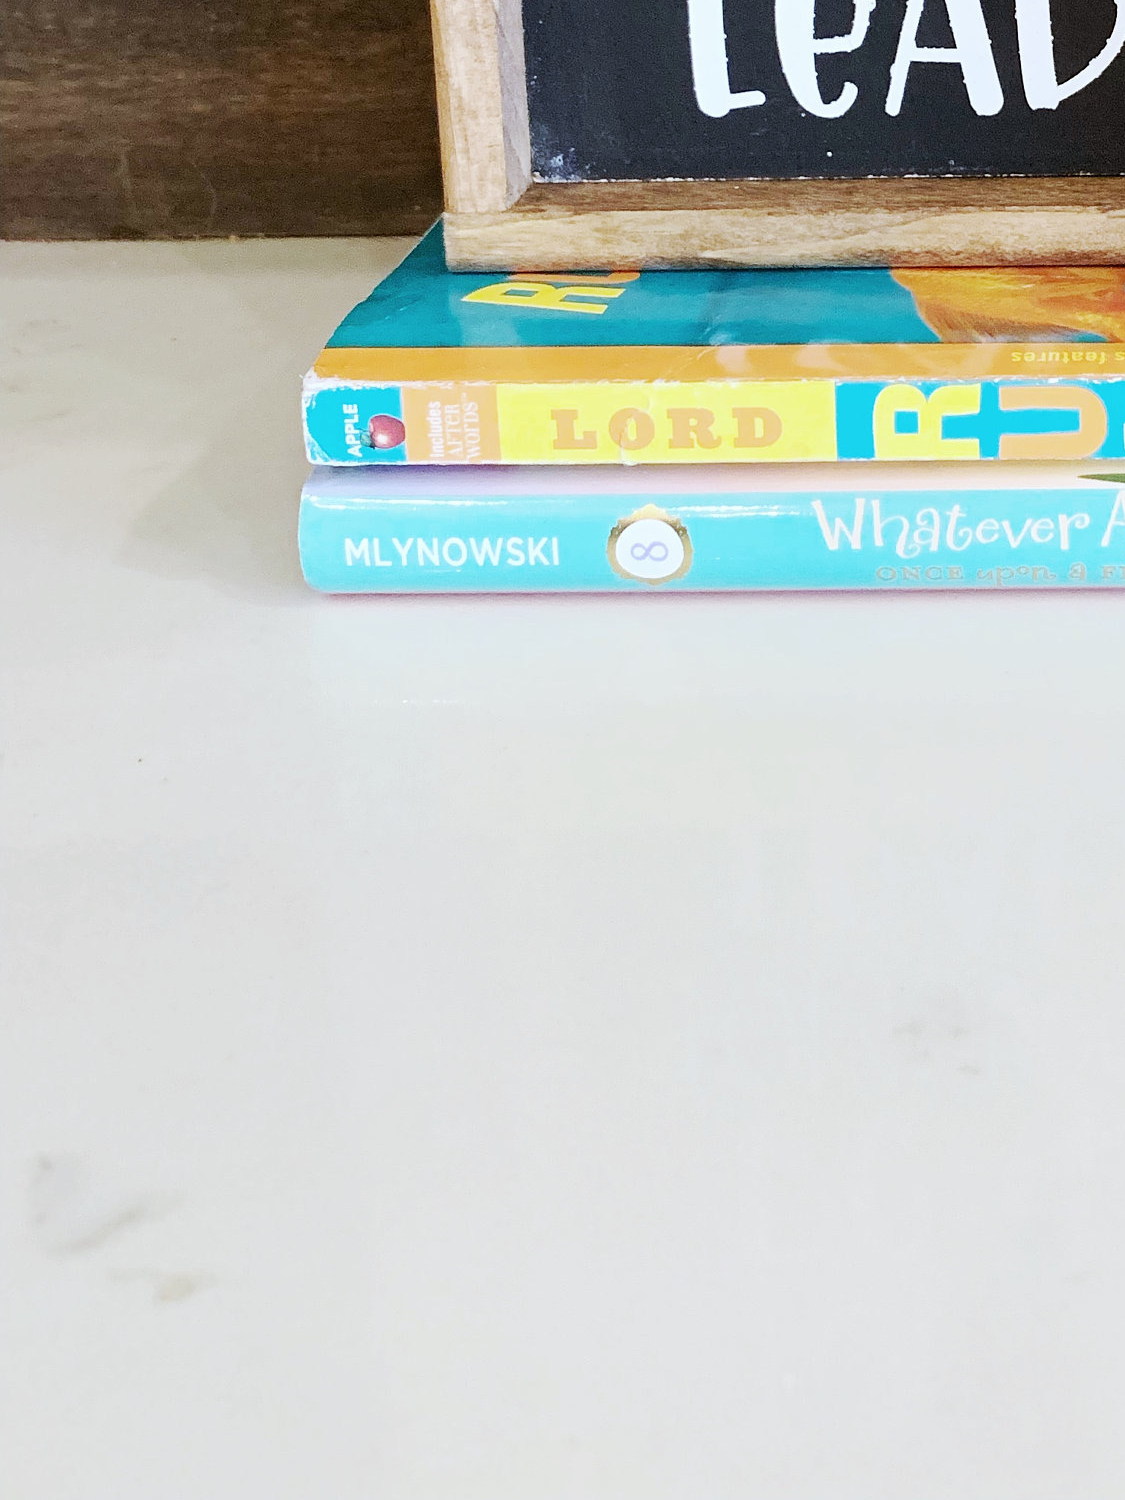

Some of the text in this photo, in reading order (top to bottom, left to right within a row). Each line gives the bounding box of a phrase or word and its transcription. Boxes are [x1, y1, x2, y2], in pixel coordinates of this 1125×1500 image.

[1011, 352, 1107, 367] features
[342, 403, 363, 457] APPLE
[426, 400, 446, 458] Includes
[552, 408, 783, 451] LORD
[812, 497, 1091, 559] Whatever
[344, 536, 560, 567] MLYNOWSKI
[875, 564, 965, 581] ONCE
[975, 564, 1058, 588] upon
